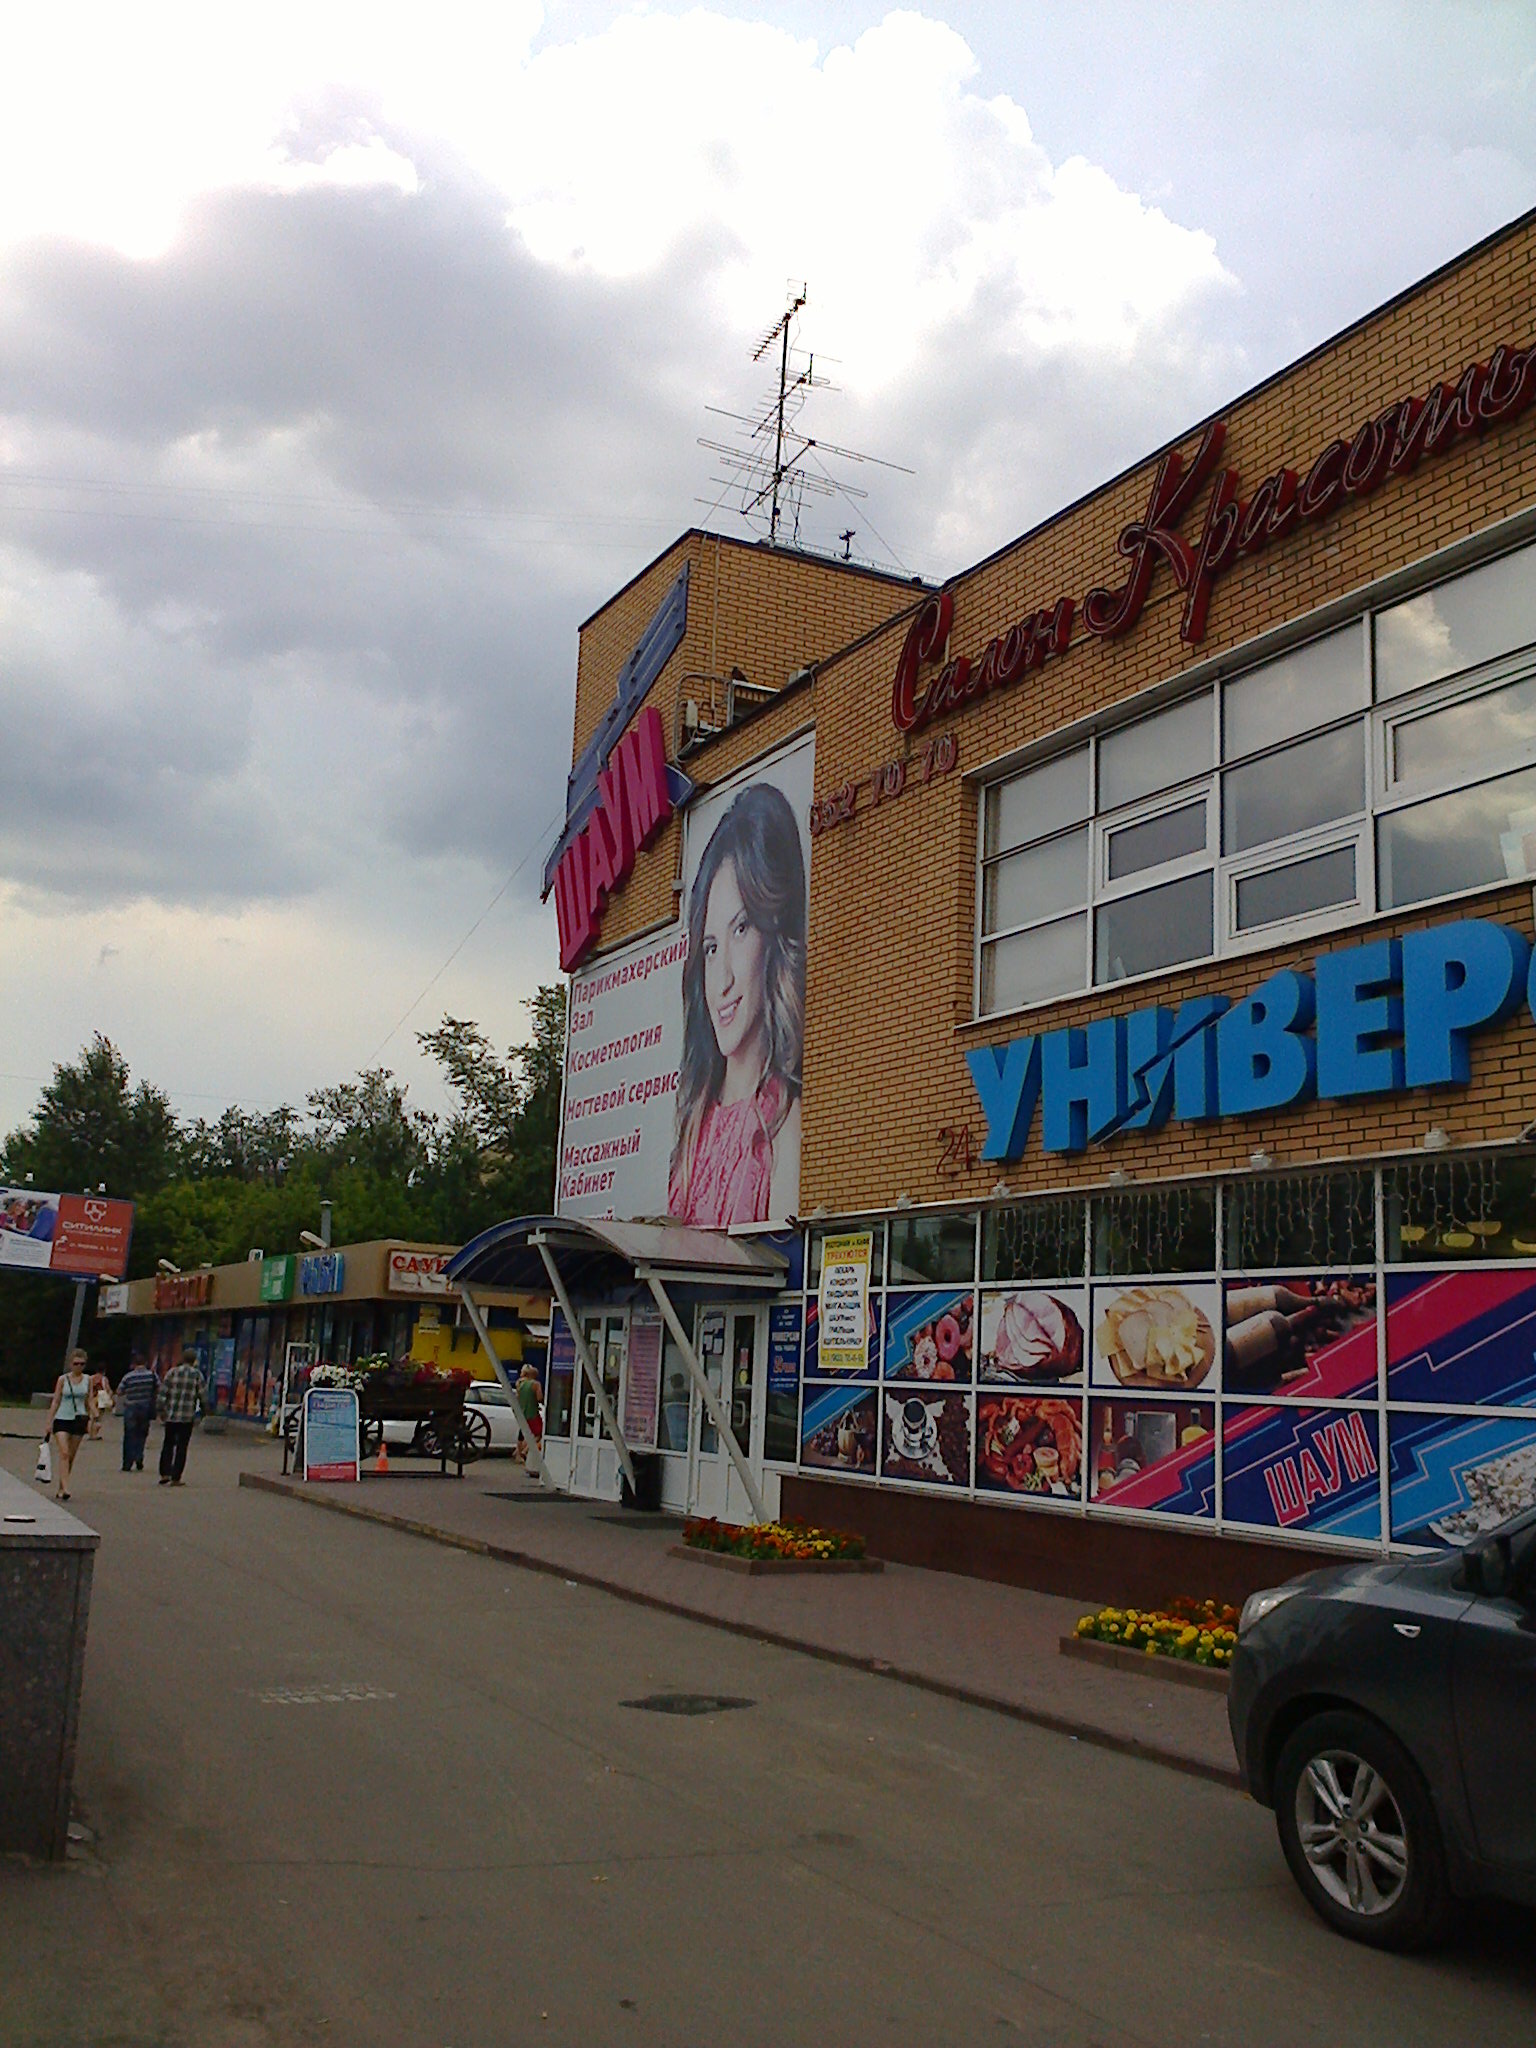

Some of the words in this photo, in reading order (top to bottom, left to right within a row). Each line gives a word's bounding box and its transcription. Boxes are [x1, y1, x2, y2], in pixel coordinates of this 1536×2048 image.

[892, 593, 1076, 732] Салон
[871, 758, 905, 807] 70
[920, 729, 958, 784] 70
[553, 707, 673, 973] ШАУМ
[574, 934, 688, 1005] Парикмахерский
[569, 1024, 662, 1074] Косметология
[572, 1010, 594, 1034] Зал
[965, 919, 1536, 1162] УНИВЕР
[566, 1081, 626, 1121] Ногтевой
[628, 1071, 679, 1105] сервис
[563, 1127, 641, 1168] Массажный
[561, 1170, 615, 1199] Кабинет
[1264, 1411, 1378, 1527] ШАУМ
